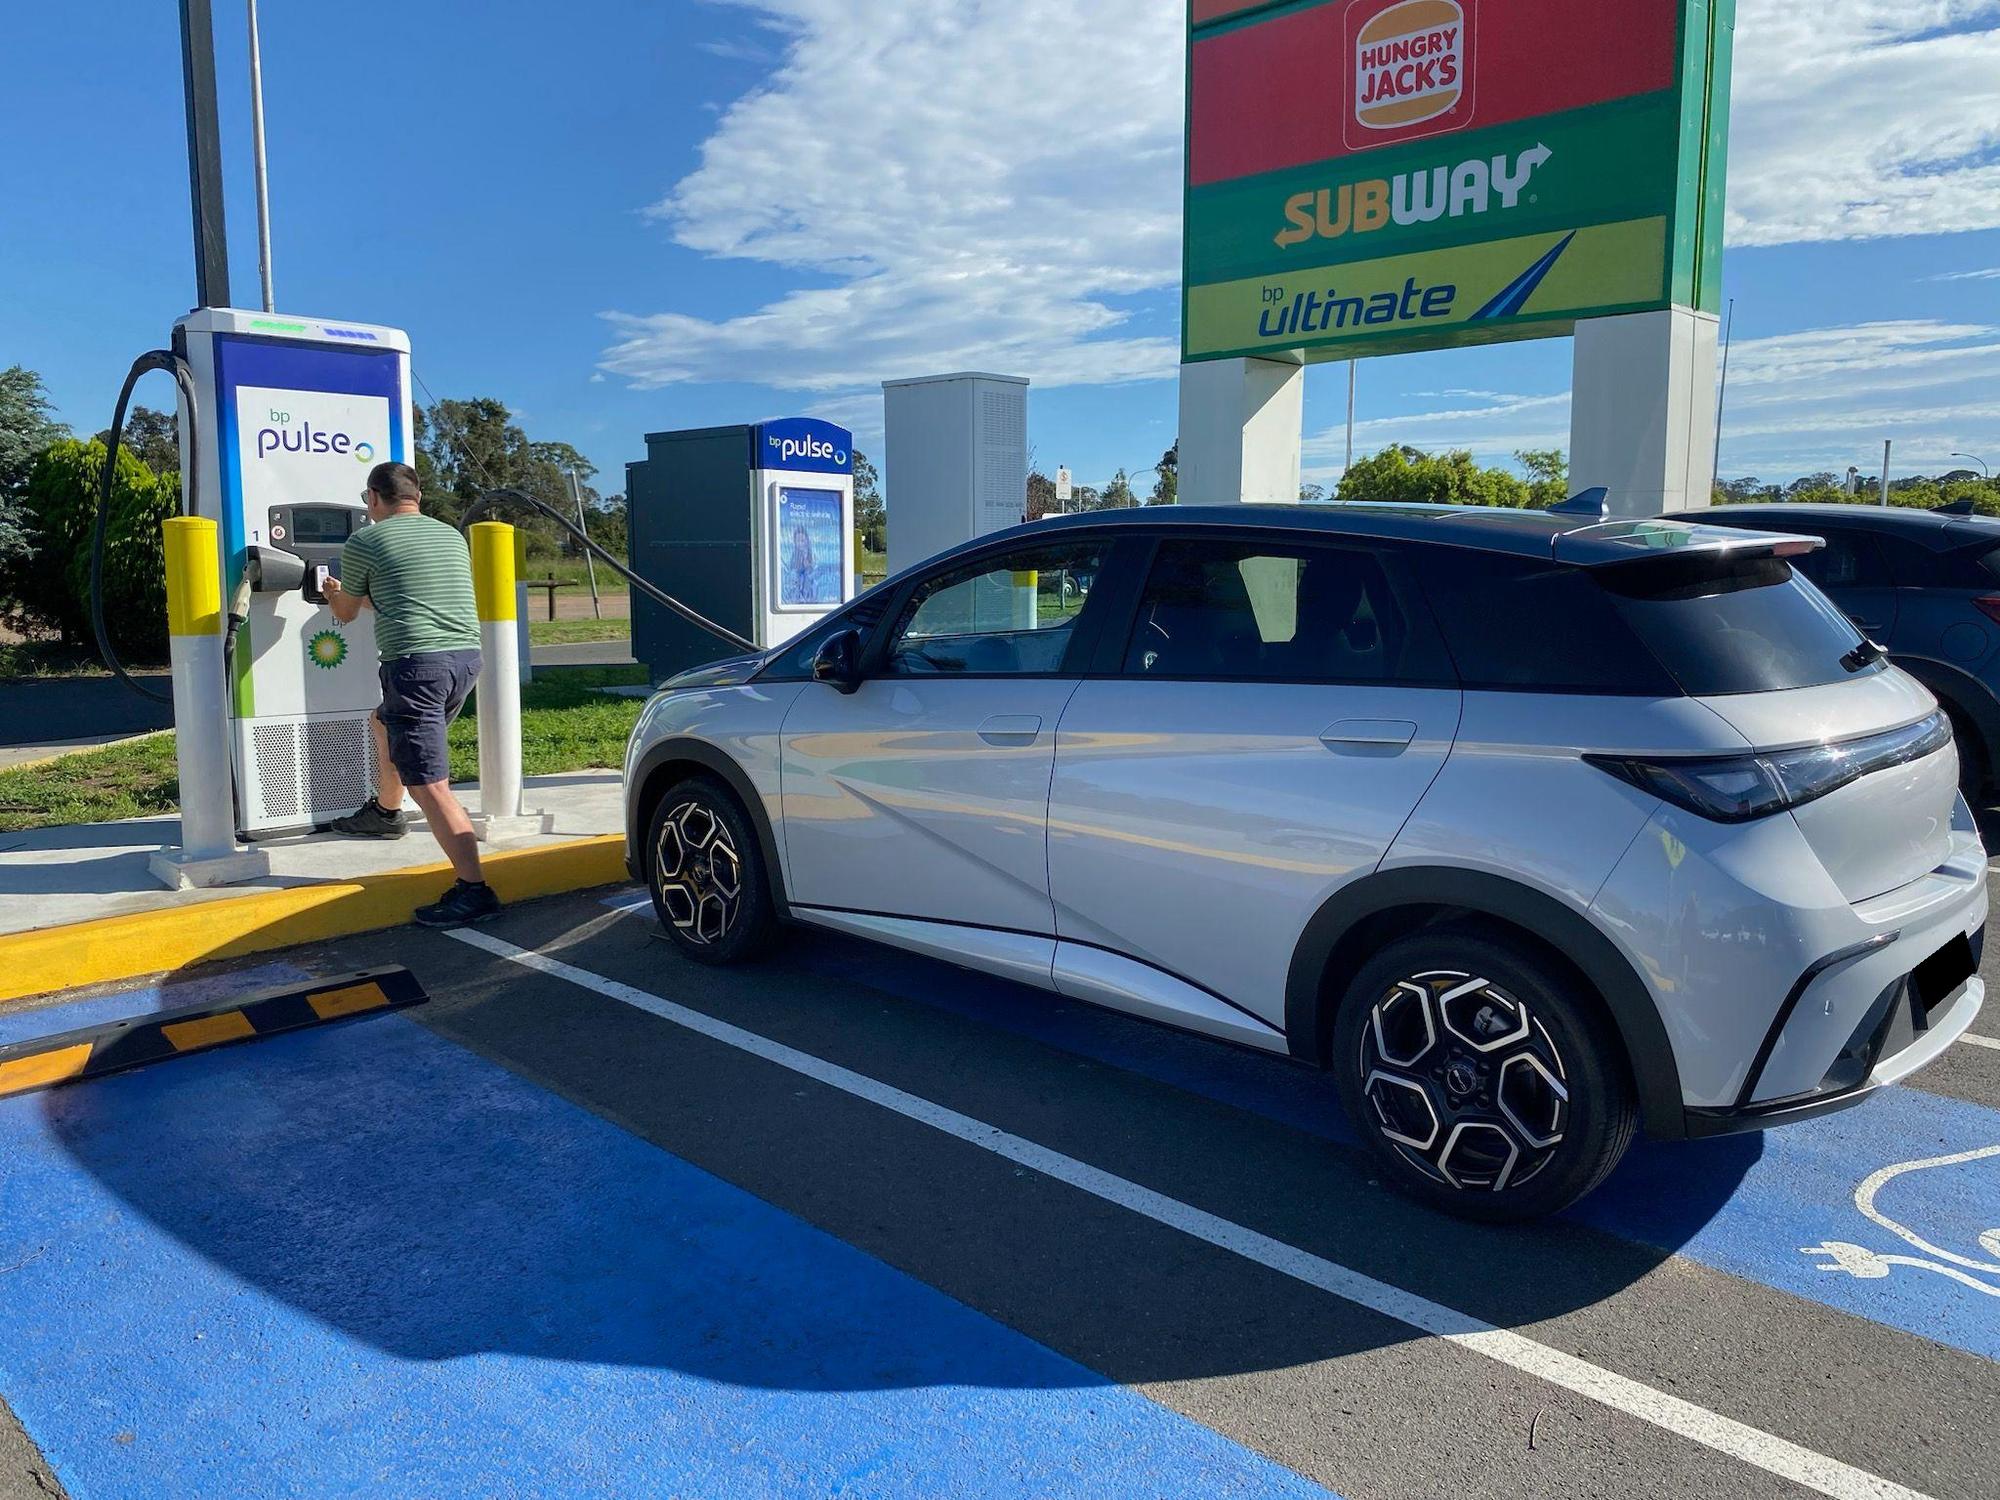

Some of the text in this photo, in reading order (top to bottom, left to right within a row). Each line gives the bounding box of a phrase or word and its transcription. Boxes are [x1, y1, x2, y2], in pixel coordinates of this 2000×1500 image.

[1361, 28, 1457, 71] HUNGRY
[1361, 56, 1457, 104] JACK'S
[1273, 141, 1553, 250] SUBWAY
[1258, 277, 1456, 337] ultimate
[1262, 286, 1284, 304] bp
[270, 408, 290, 425] bp
[258, 421, 352, 458] pulse
[769, 434, 834, 461] bp pulse
[252, 530, 259, 542] 1
